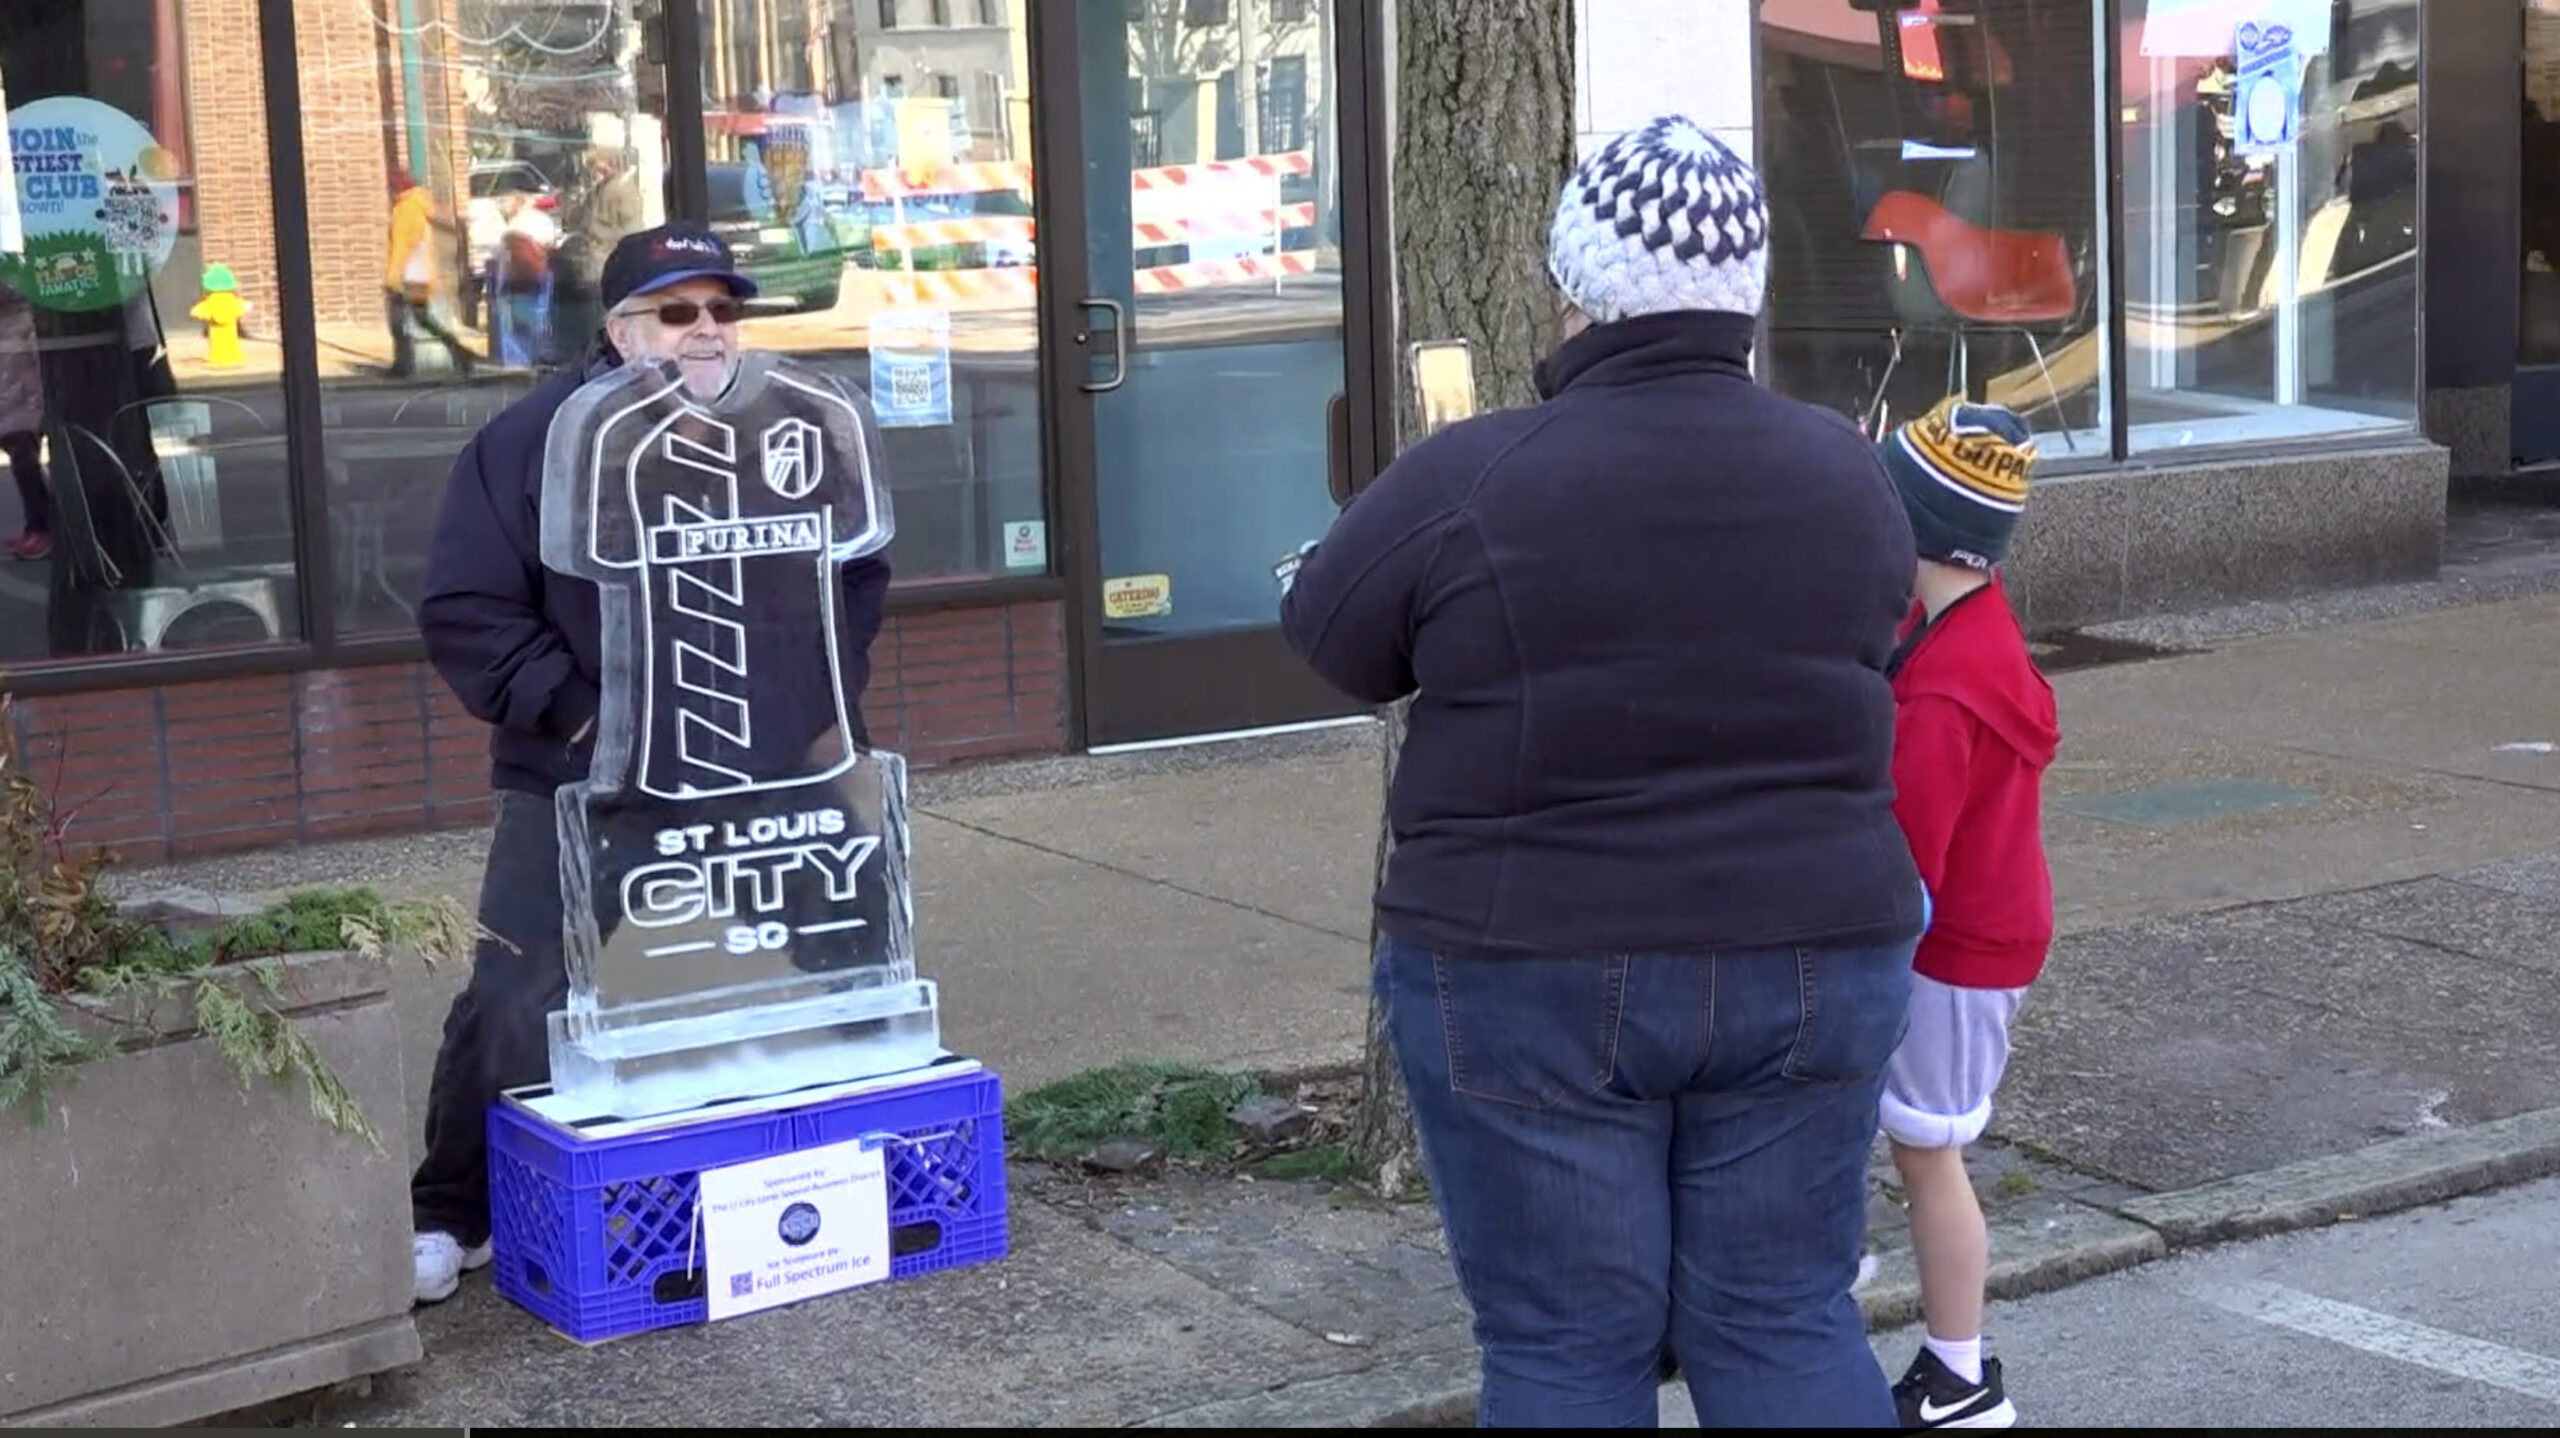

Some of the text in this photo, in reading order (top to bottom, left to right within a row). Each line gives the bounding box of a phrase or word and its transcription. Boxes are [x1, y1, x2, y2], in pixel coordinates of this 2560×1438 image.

[77, 132, 98, 146] the
[26, 174, 99, 199] CLUB
[687, 521, 814, 553] PURINA
[655, 809, 845, 855] ST LOUIS
[620, 836, 881, 928] CITY
[757, 1255, 871, 1291] Full Spectrum Ice
